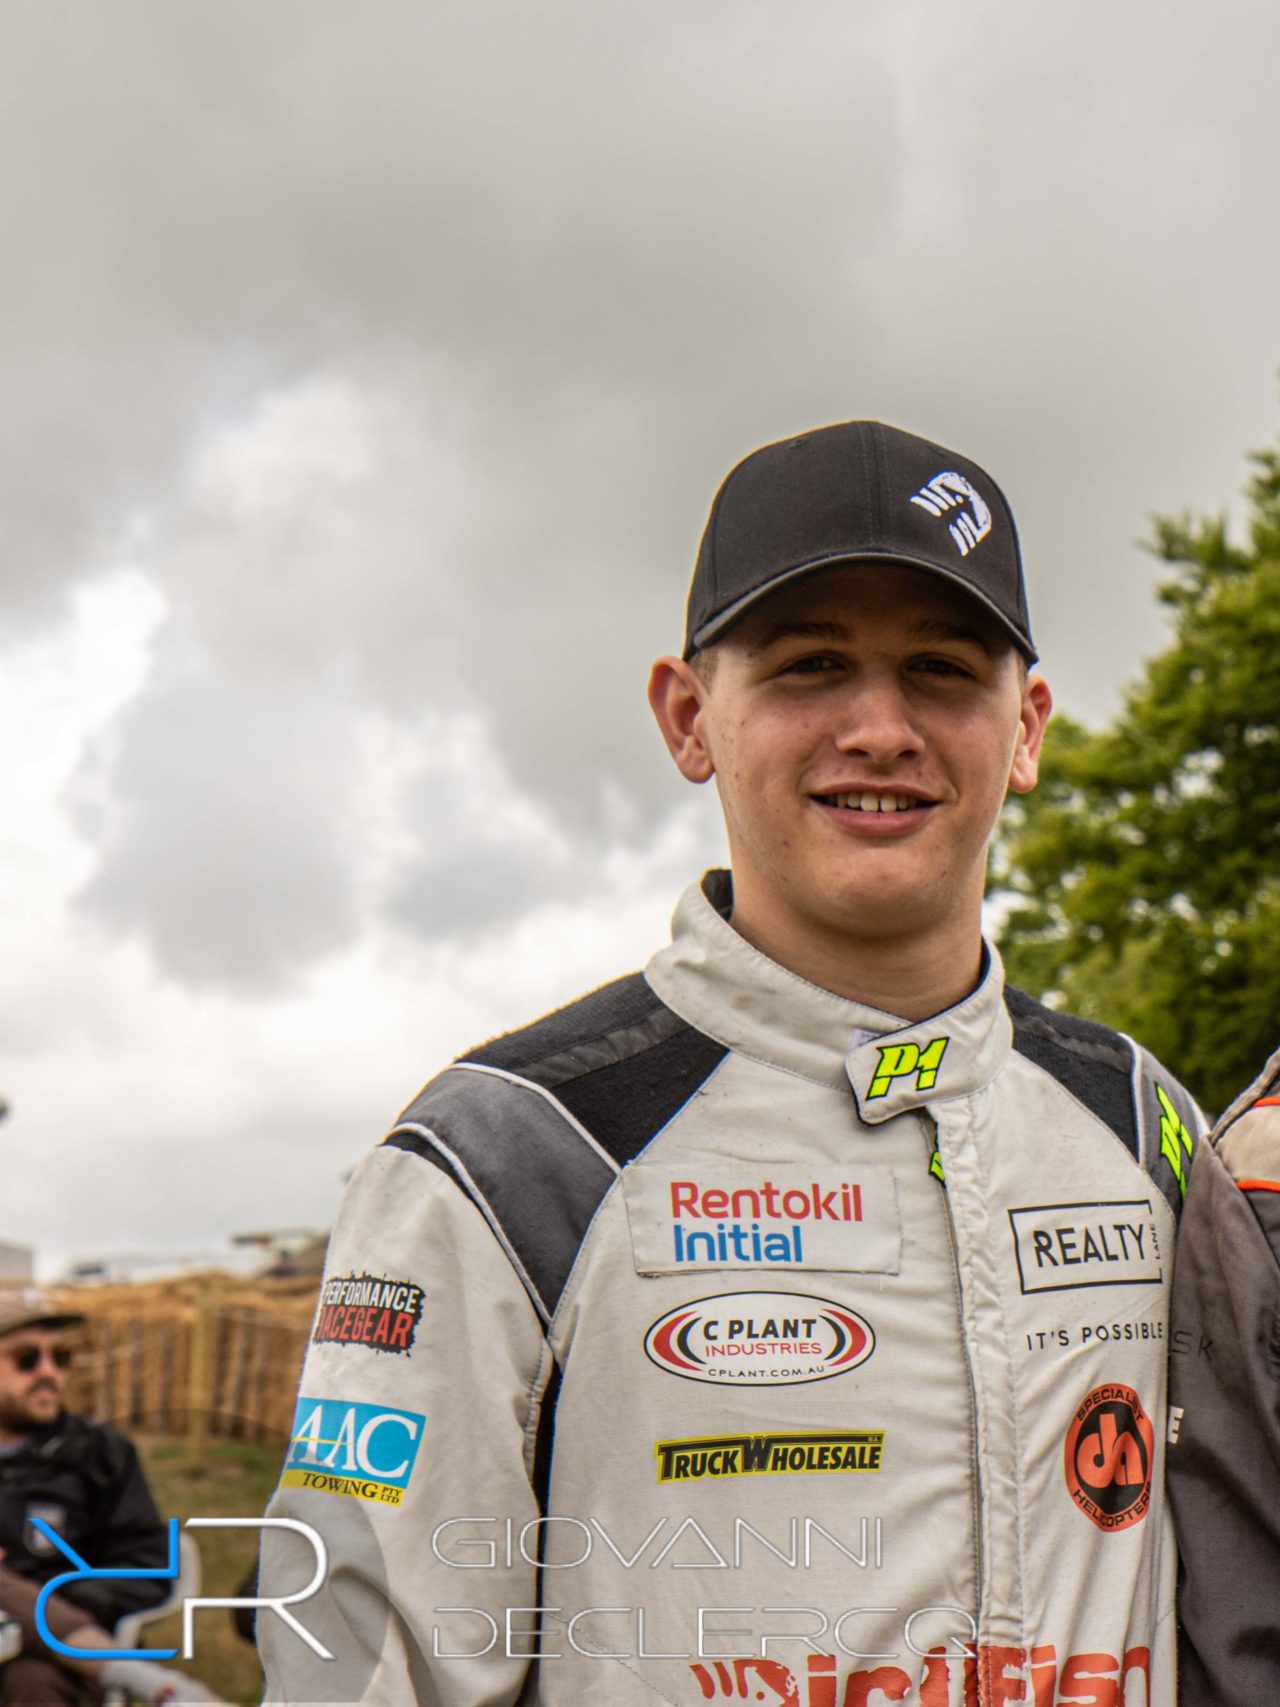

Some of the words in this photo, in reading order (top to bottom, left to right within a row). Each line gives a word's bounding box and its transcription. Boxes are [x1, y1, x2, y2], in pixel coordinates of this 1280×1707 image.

[865, 1037, 950, 1101] P1
[670, 1182, 863, 1221] Rentokil
[673, 1224, 803, 1262] Initial
[1033, 1224, 1144, 1267] REALTY
[322, 1281, 421, 1314] PERFORMANCE
[703, 1320, 719, 1341] C
[728, 1319, 817, 1339] PLANT
[1027, 1330, 1070, 1351] IT'S
[1082, 1322, 1163, 1343] POSSIBLE
[705, 1342, 822, 1357] INDUSTRIES
[708, 1366, 825, 1377] CPLANT.COM.AU
[286, 1404, 418, 1478] AAC
[302, 1472, 378, 1498] TOWING
[381, 1486, 402, 1497] PTY
[380, 1494, 400, 1504] LTD
